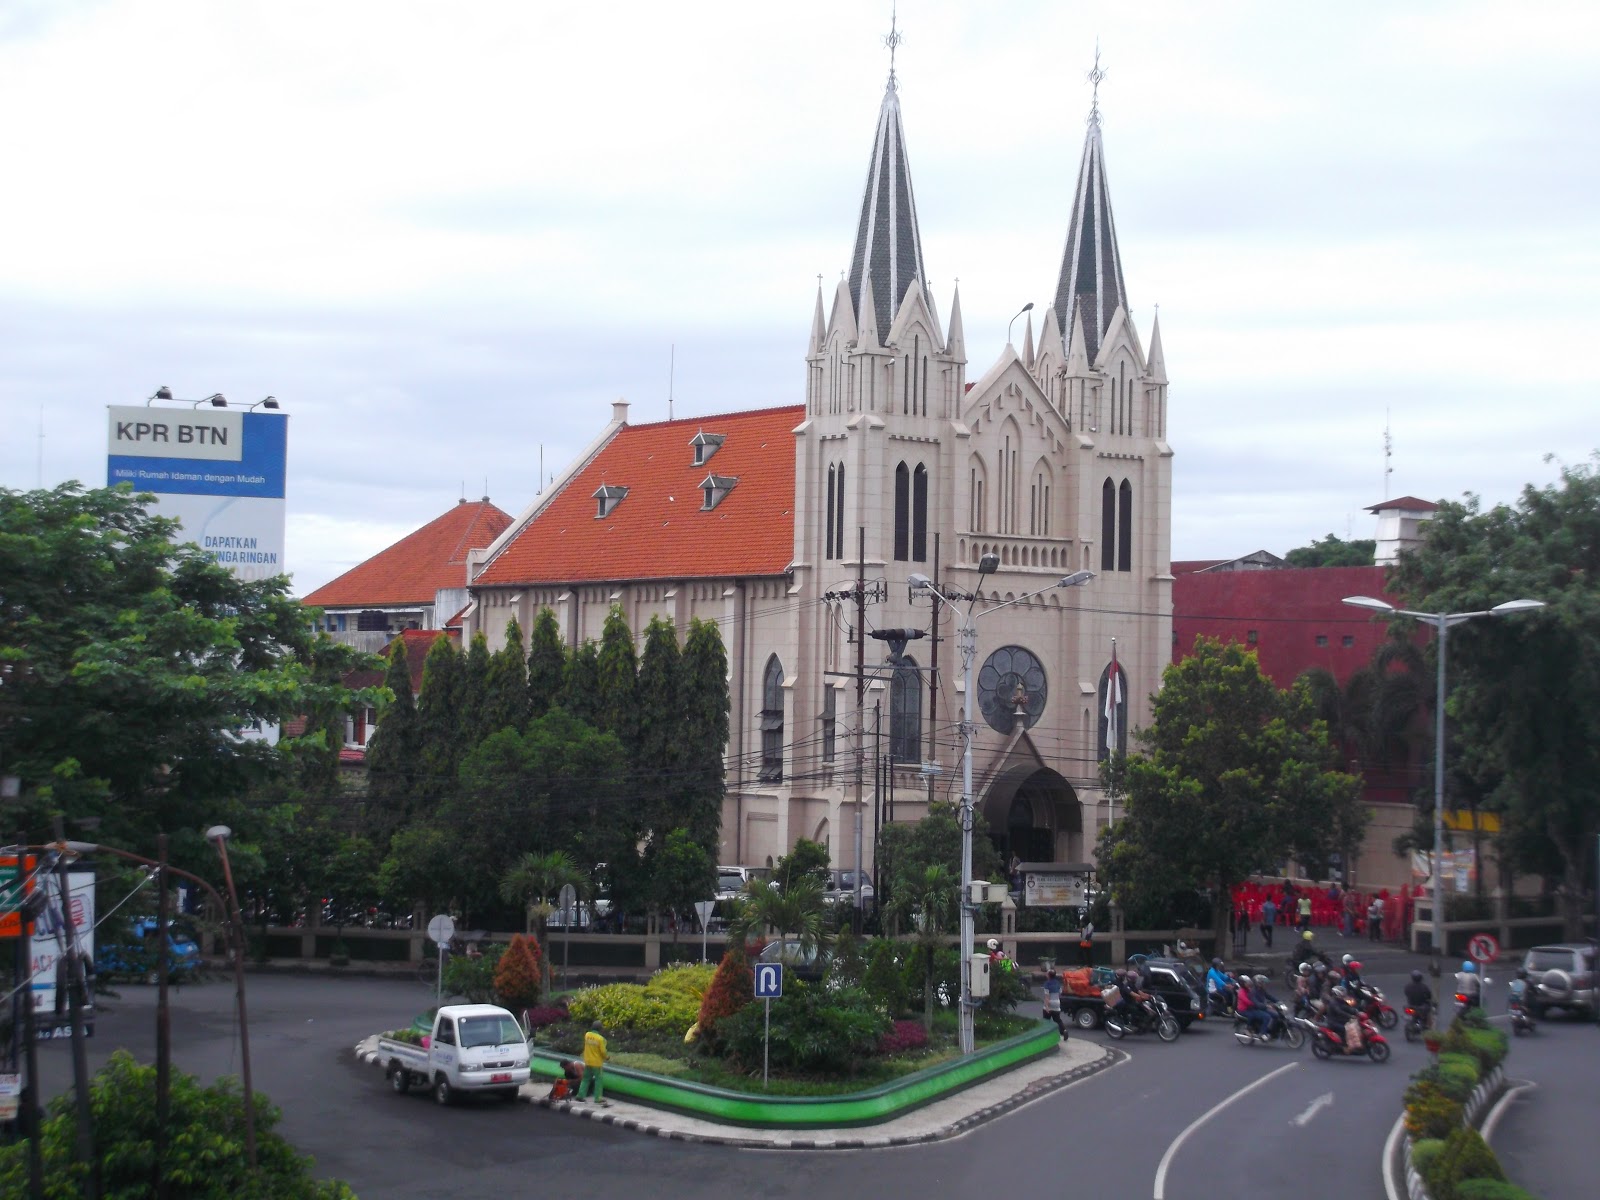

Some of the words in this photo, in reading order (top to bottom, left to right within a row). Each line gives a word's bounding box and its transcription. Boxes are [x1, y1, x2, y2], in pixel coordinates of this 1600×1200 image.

[117, 421, 169, 443] KPR
[178, 425, 228, 446] BTN
[115, 469, 137, 478] Miliki
[139, 470, 170, 480] Rumah
[171, 472, 203, 481] Idaman
[204, 473, 236, 484] dengan
[237, 475, 266, 484] Mudah
[205, 535, 258, 549] DAPATKAN
[205, 551, 238, 563] NGA
[239, 551, 278, 564] RINGAN
